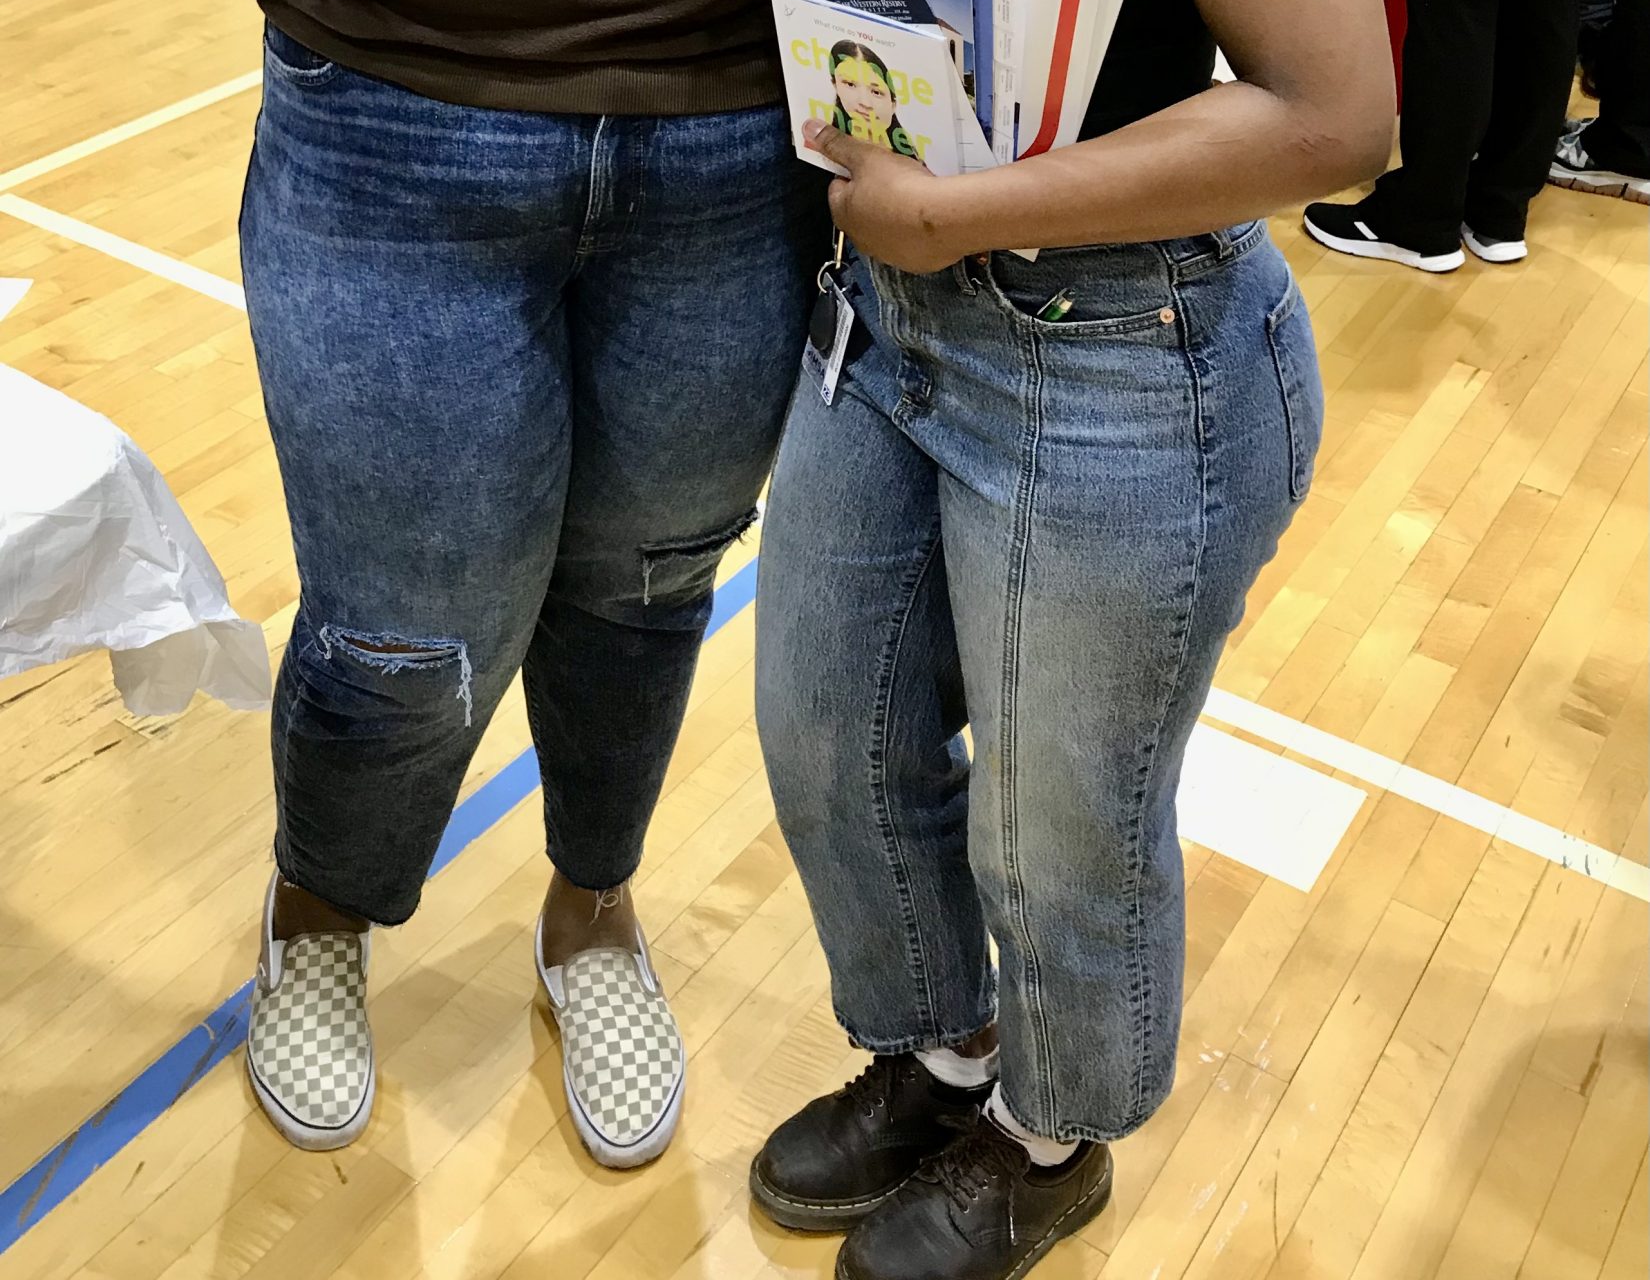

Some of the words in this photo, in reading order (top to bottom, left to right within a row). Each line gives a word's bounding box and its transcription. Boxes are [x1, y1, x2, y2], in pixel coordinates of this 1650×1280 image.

[856, 31, 873, 42] YOU
[790, 37, 934, 106] change
[808, 97, 932, 161] maker
